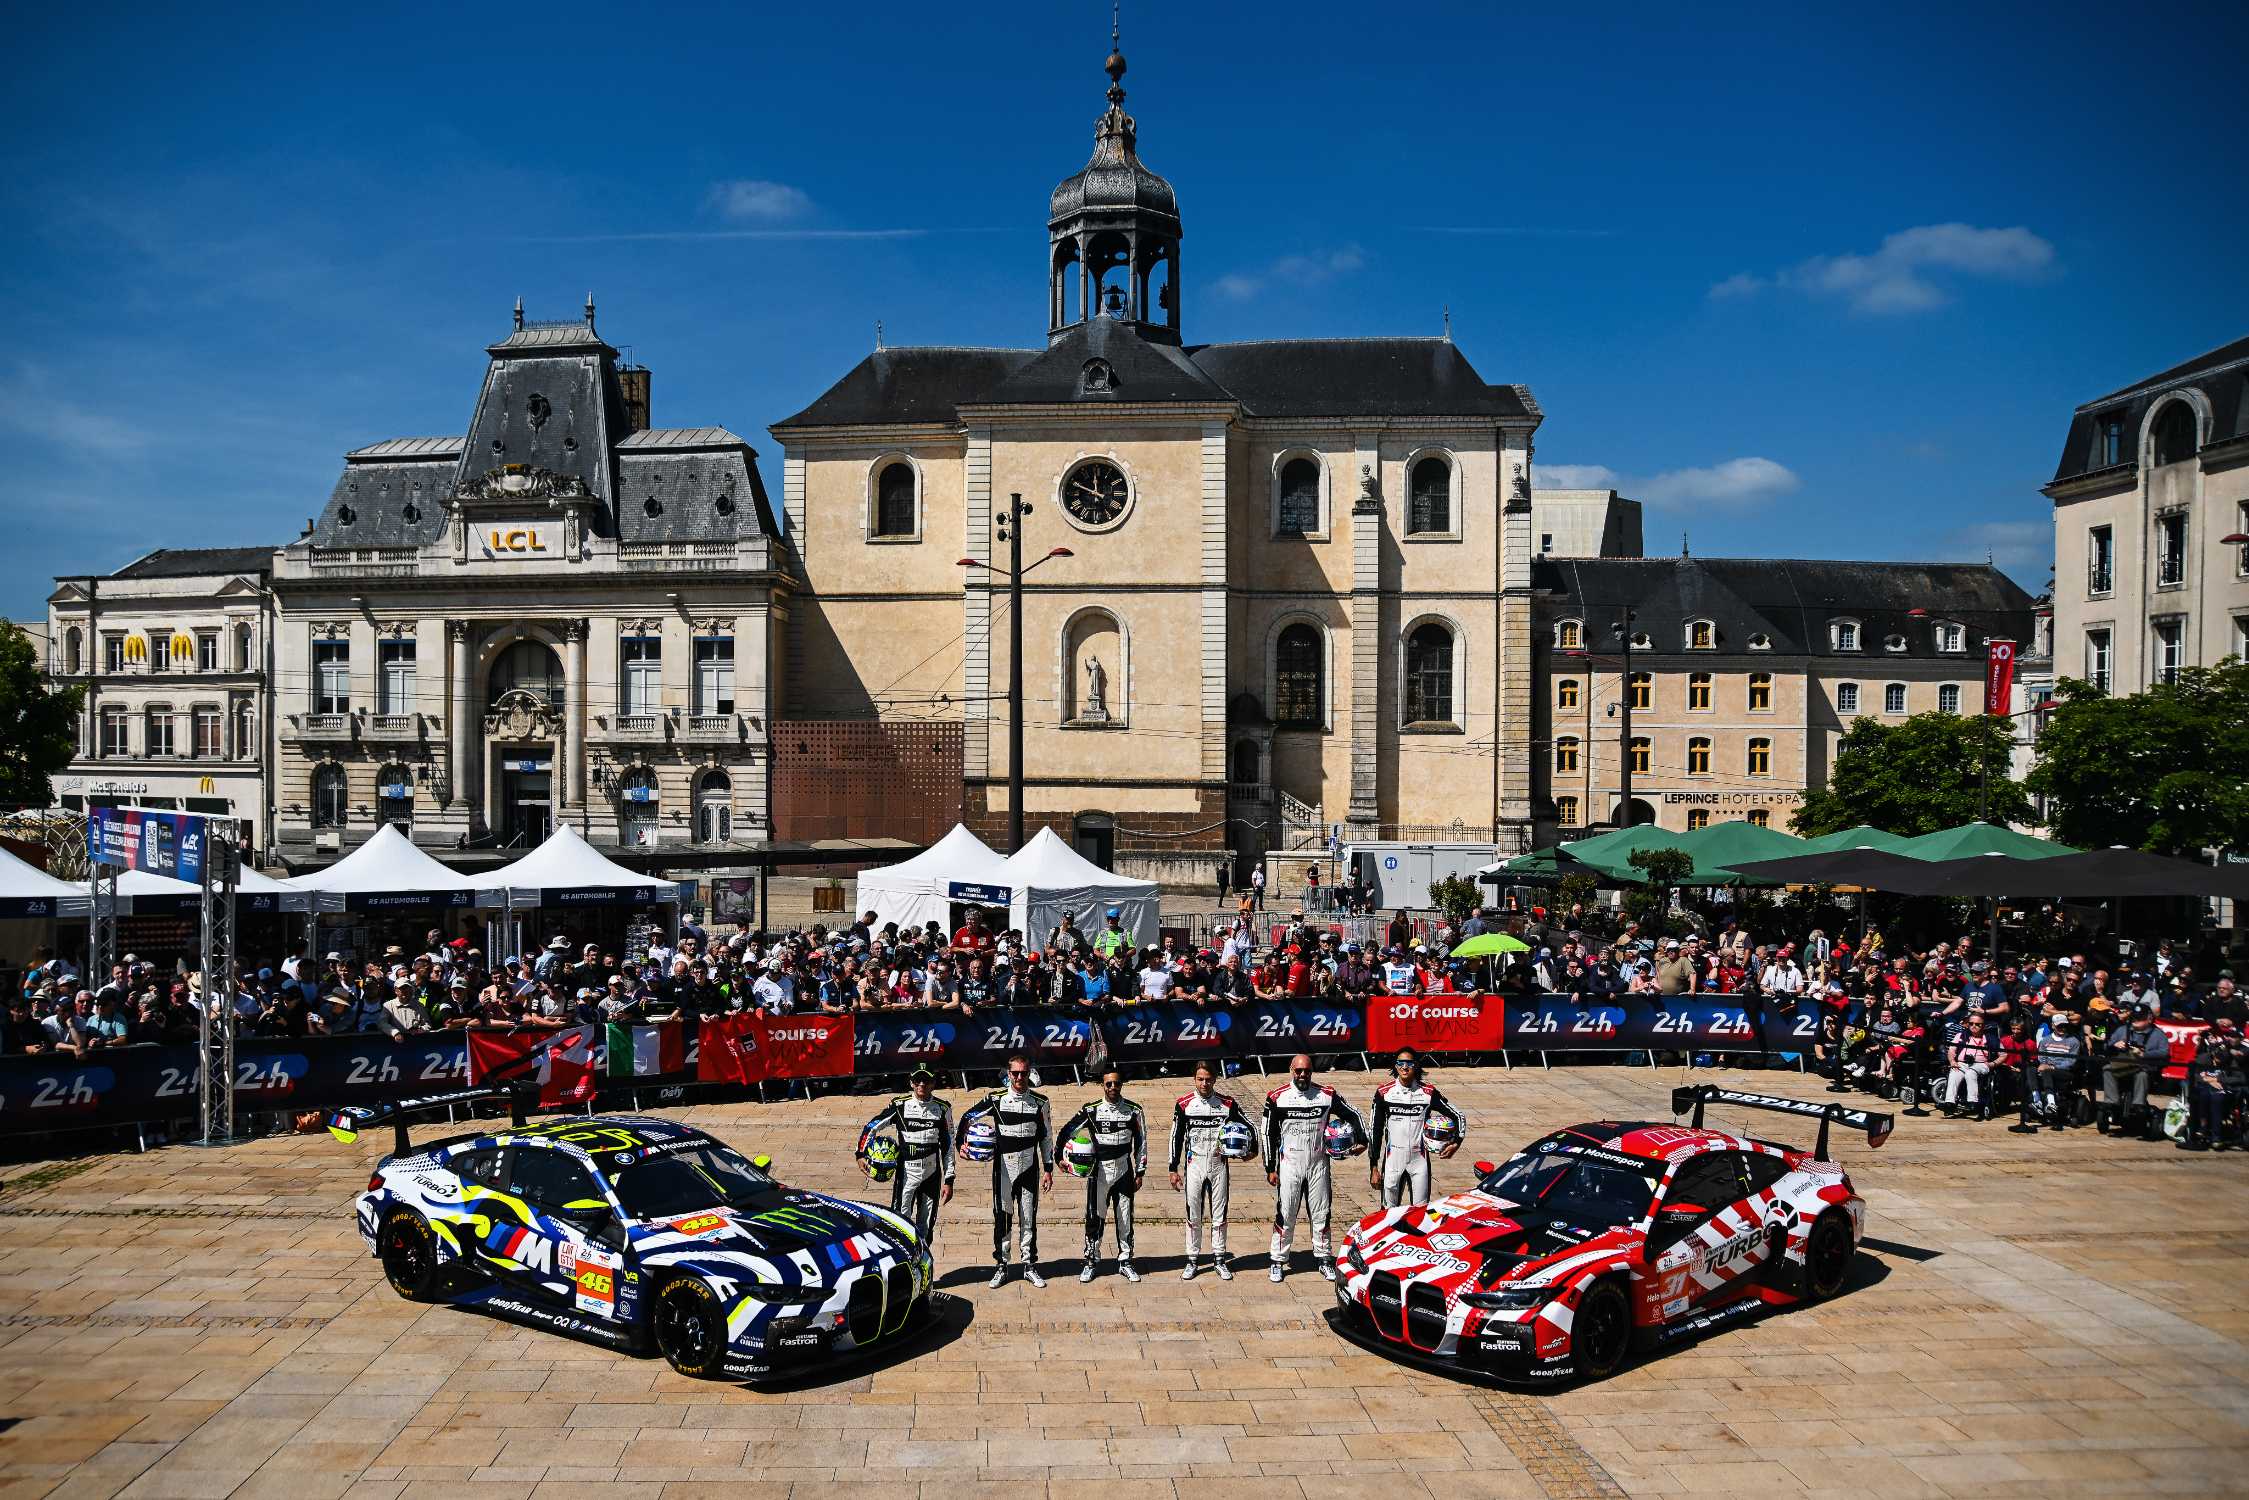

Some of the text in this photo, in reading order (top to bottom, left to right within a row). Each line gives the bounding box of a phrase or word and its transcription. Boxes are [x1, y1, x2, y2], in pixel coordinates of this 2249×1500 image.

[491, 530, 545, 550] LCL
[89, 782, 147, 793] McDonald's
[1664, 793, 1718, 804] LEPRINCE
[1776, 794, 1800, 804] SPA
[379, 896, 430, 904] AUTOMOBILES
[571, 892, 616, 900] AUTOMOBILES
[1422, 1005, 1479, 1018] course
[1124, 1020, 1163, 1044] 24h
[1177, 1016, 1217, 1040] 24h
[1256, 1014, 1295, 1037] 24h
[1309, 1014, 1347, 1036] 24h
[1425, 1020, 1480, 1036] MANS
[1518, 1012, 1558, 1033] 24h
[1571, 1012, 1613, 1033] 24h
[1652, 1012, 1693, 1033] 24h
[1708, 1012, 1751, 1034] 24h
[1792, 1014, 1818, 1036] 24
[897, 1028, 941, 1053] 24h
[983, 1026, 1025, 1050] 24h
[1040, 1024, 1084, 1047] 24h
[233, 1060, 289, 1090] 24h
[346, 1055, 400, 1084] 24h
[30, 1075, 94, 1108] 24h
[659, 1138, 711, 1151] Motorsport
[1584, 1148, 1646, 1169] Motorsport
[411, 1175, 448, 1196] TURBO
[681, 1216, 719, 1231] 46
[1546, 1229, 1581, 1244] Motorsport
[1384, 1240, 1471, 1273] paradine
[579, 1271, 612, 1294] 46
[661, 1279, 710, 1300] GOODYEAR
[487, 1297, 532, 1315] GOODYEAR
[553, 1315, 570, 1328] OQ
[779, 1337, 818, 1346] Fastron
[1480, 1341, 1520, 1351] Fastron
[723, 1364, 770, 1374] GOODYEAR
[1529, 1367, 1574, 1377] GOODYEAR
